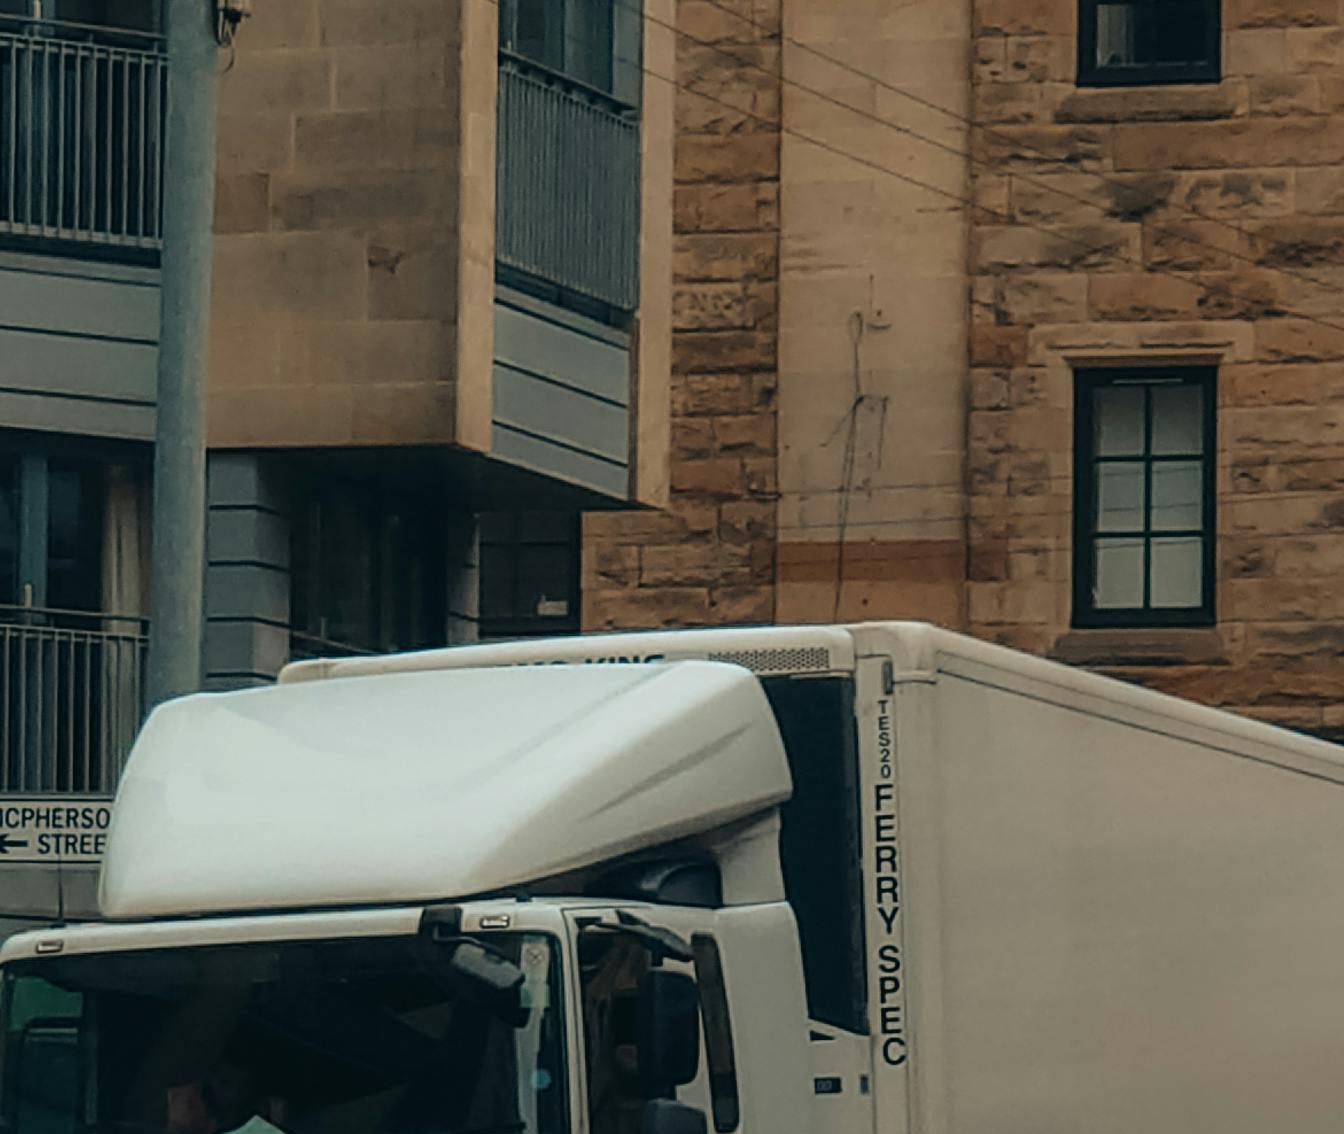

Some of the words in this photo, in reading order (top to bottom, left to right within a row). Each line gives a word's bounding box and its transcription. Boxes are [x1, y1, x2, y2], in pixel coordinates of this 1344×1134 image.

[877, 699, 892, 779] TES20
[37, 833, 107, 855] STREE
[874, 784, 899, 934] FERRY
[878, 945, 906, 1065] SPEC
